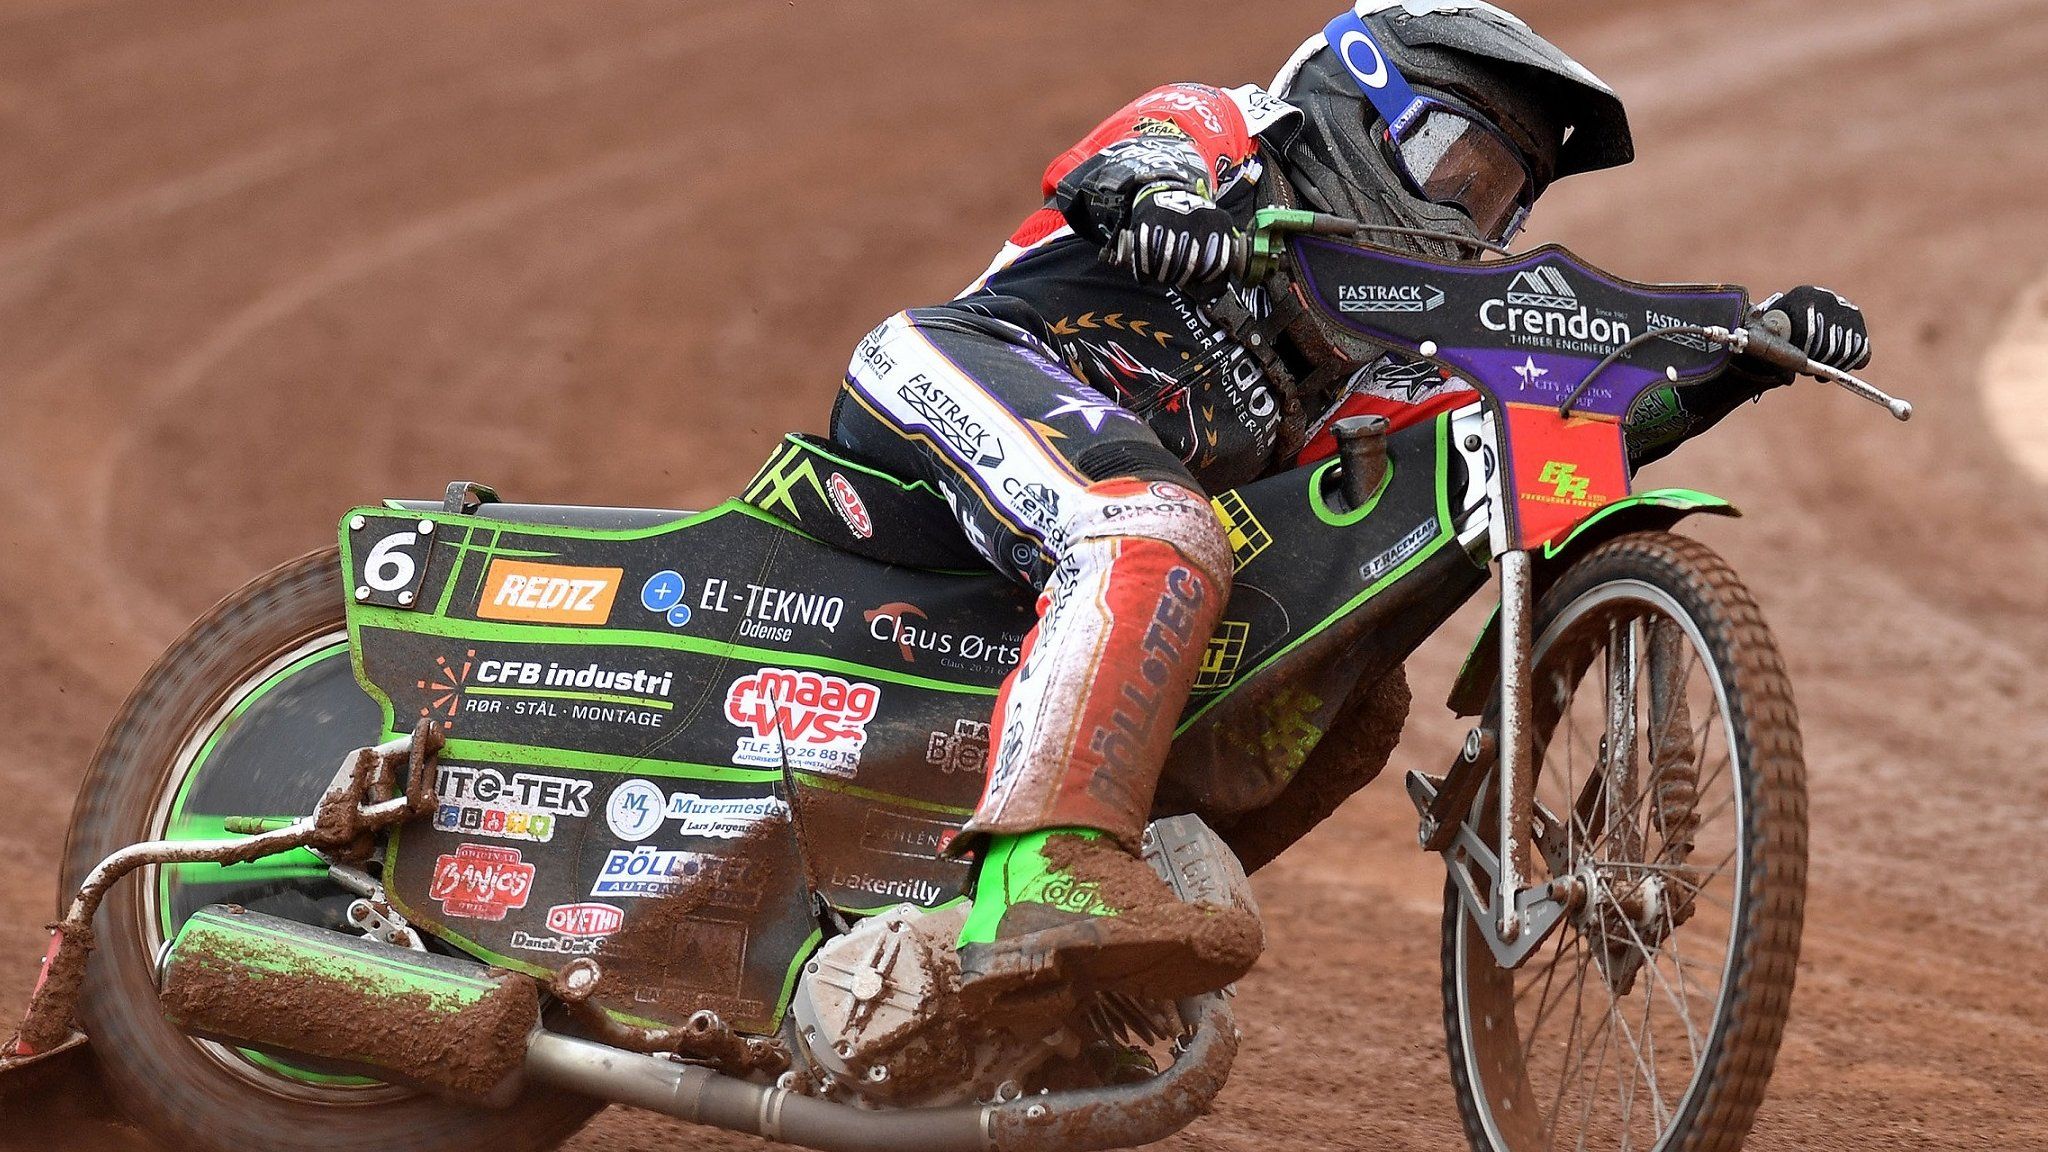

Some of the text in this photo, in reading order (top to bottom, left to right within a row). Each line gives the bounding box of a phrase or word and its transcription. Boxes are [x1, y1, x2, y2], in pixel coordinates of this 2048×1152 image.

[1338, 285, 1422, 300] FASTRACK
[1165, 287, 1212, 351] TIMBER
[1478, 299, 1631, 344] Crendon
[1646, 310, 1705, 339] FASTRAC
[859, 340, 892, 375] ndon
[1510, 335, 1632, 359] TIMBER ENGINEERIG
[1555, 394, 1594, 408] GUP
[1564, 384, 1613, 399] AUTION
[908, 373, 990, 447] FASTRACK
[364, 532, 417, 591] 6
[493, 574, 608, 611] REDTZ
[700, 578, 844, 633] EL-TEKNIQ
[739, 619, 792, 642] Odense
[870, 614, 952, 653] Claus
[477, 660, 673, 697] CFB industri
[465, 699, 663, 727] RØR STÅL MONTAGE
[797, 748, 816, 757] 26
[820, 749, 838, 760] 88
[841, 752, 857, 764] 15
[687, 821, 709, 830] Lars
